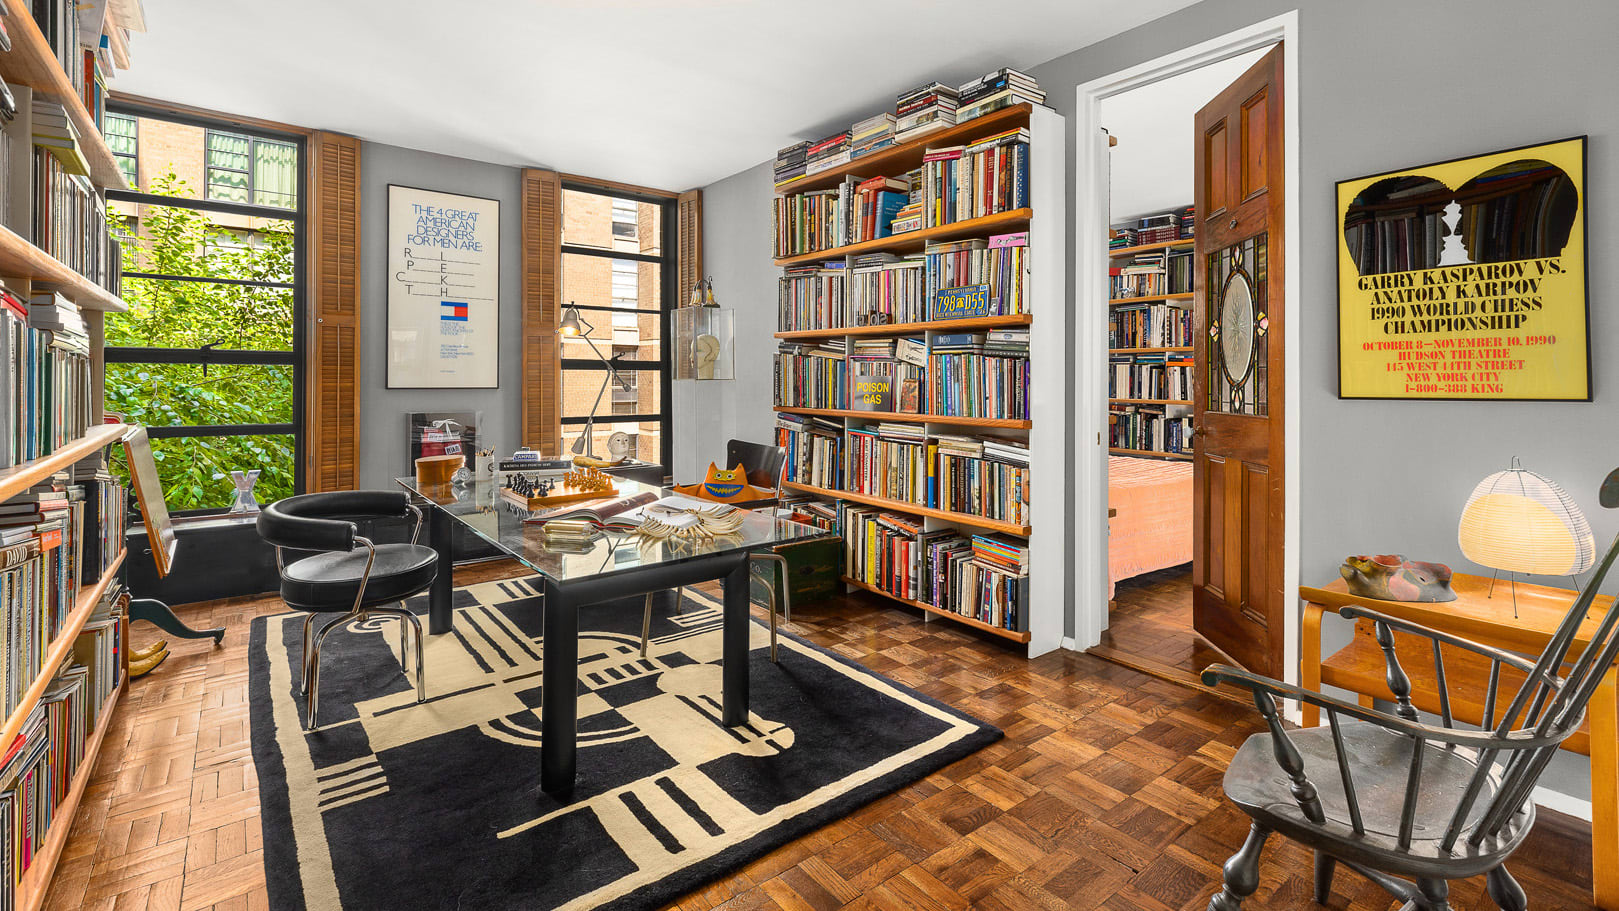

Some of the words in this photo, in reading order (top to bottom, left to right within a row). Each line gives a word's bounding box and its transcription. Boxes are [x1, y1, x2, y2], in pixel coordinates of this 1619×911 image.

[412, 204, 435, 217] THE
[436, 208, 443, 217] 4
[445, 209, 480, 222] GREAT
[416, 216, 475, 231] AMERICAN
[417, 225, 475, 241] DESIGNERS
[407, 234, 431, 246] FOR
[433, 237, 458, 249] MEN
[1358, 272, 1418, 291] GARRY
[1422, 262, 1528, 285] KASPAROV
[1535, 258, 1567, 276] VS.
[1370, 286, 1450, 305] ANATOLY
[1456, 278, 1543, 299] KARPOV
[938, 295, 956, 313] 798
[965, 291, 985, 310] D55
[1370, 305, 1406, 320] 1990
[1410, 301, 1477, 317] WORLD
[1481, 296, 1543, 314] CHESS
[1383, 314, 1527, 334] CHAMPIONSHIP
[1362, 341, 1413, 351] OCTOBER
[1526, 335, 1556, 346] 1990
[1398, 350, 1446, 361] HUDSON
[1450, 348, 1511, 359] THEATRE
[1386, 362, 1404, 373] 145
[1406, 361, 1439, 371] WEST
[1476, 360, 1526, 370] STREET
[1406, 373, 1433, 383] NEW
[1435, 372, 1468, 382] YORK
[1471, 371, 1502, 382] CITY
[856, 382, 889, 393] POISON
[1405, 384, 1467, 393] 1-800-388
[1471, 383, 1504, 393] KING
[863, 394, 882, 405] GAS
[6, 545, 28, 567] DAVID
